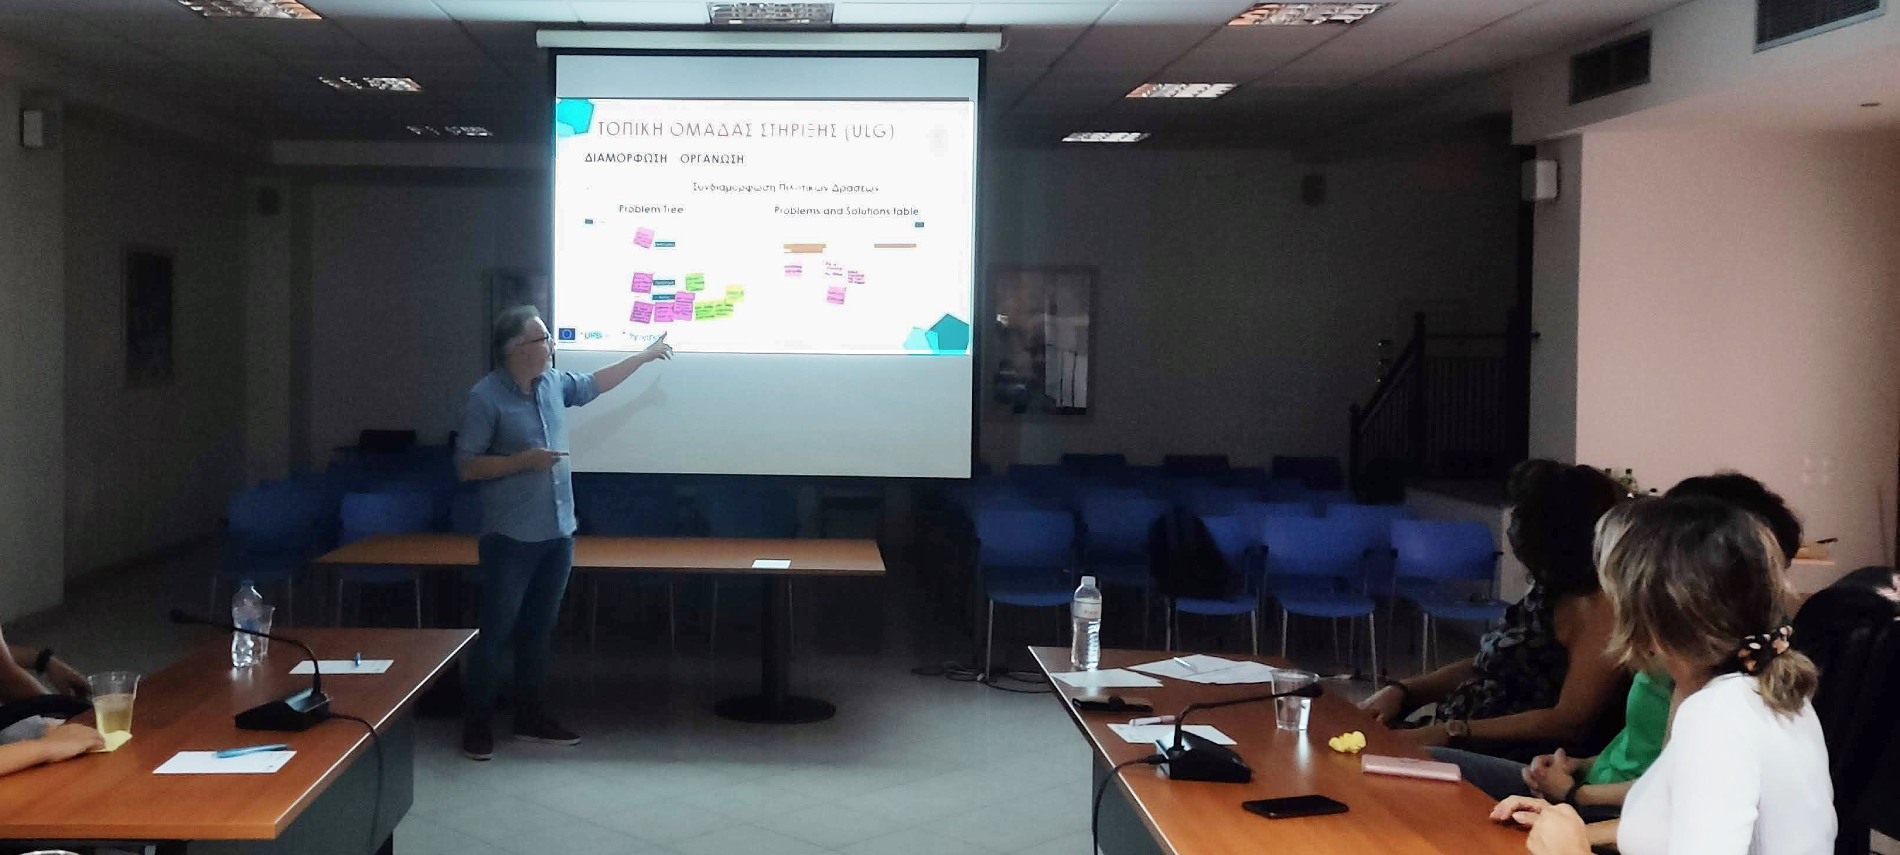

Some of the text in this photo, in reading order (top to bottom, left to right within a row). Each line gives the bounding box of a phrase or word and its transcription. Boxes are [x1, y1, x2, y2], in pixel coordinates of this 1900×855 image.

[597, 121, 895, 141] ΤΟΠΙΚΗ ΟΜΑΔΑΣ ΣΤΗΡΙΞΗΣ (ULG)
[584, 152, 744, 165] ΔΙΑΜΟΡΦΩΣΗ ΟΡΓΑΝΩΣΗ
[619, 204, 661, 214] Problem
[774, 205, 821, 215] Problems
[823, 206, 844, 215] and
[846, 205, 891, 216] Solutions
